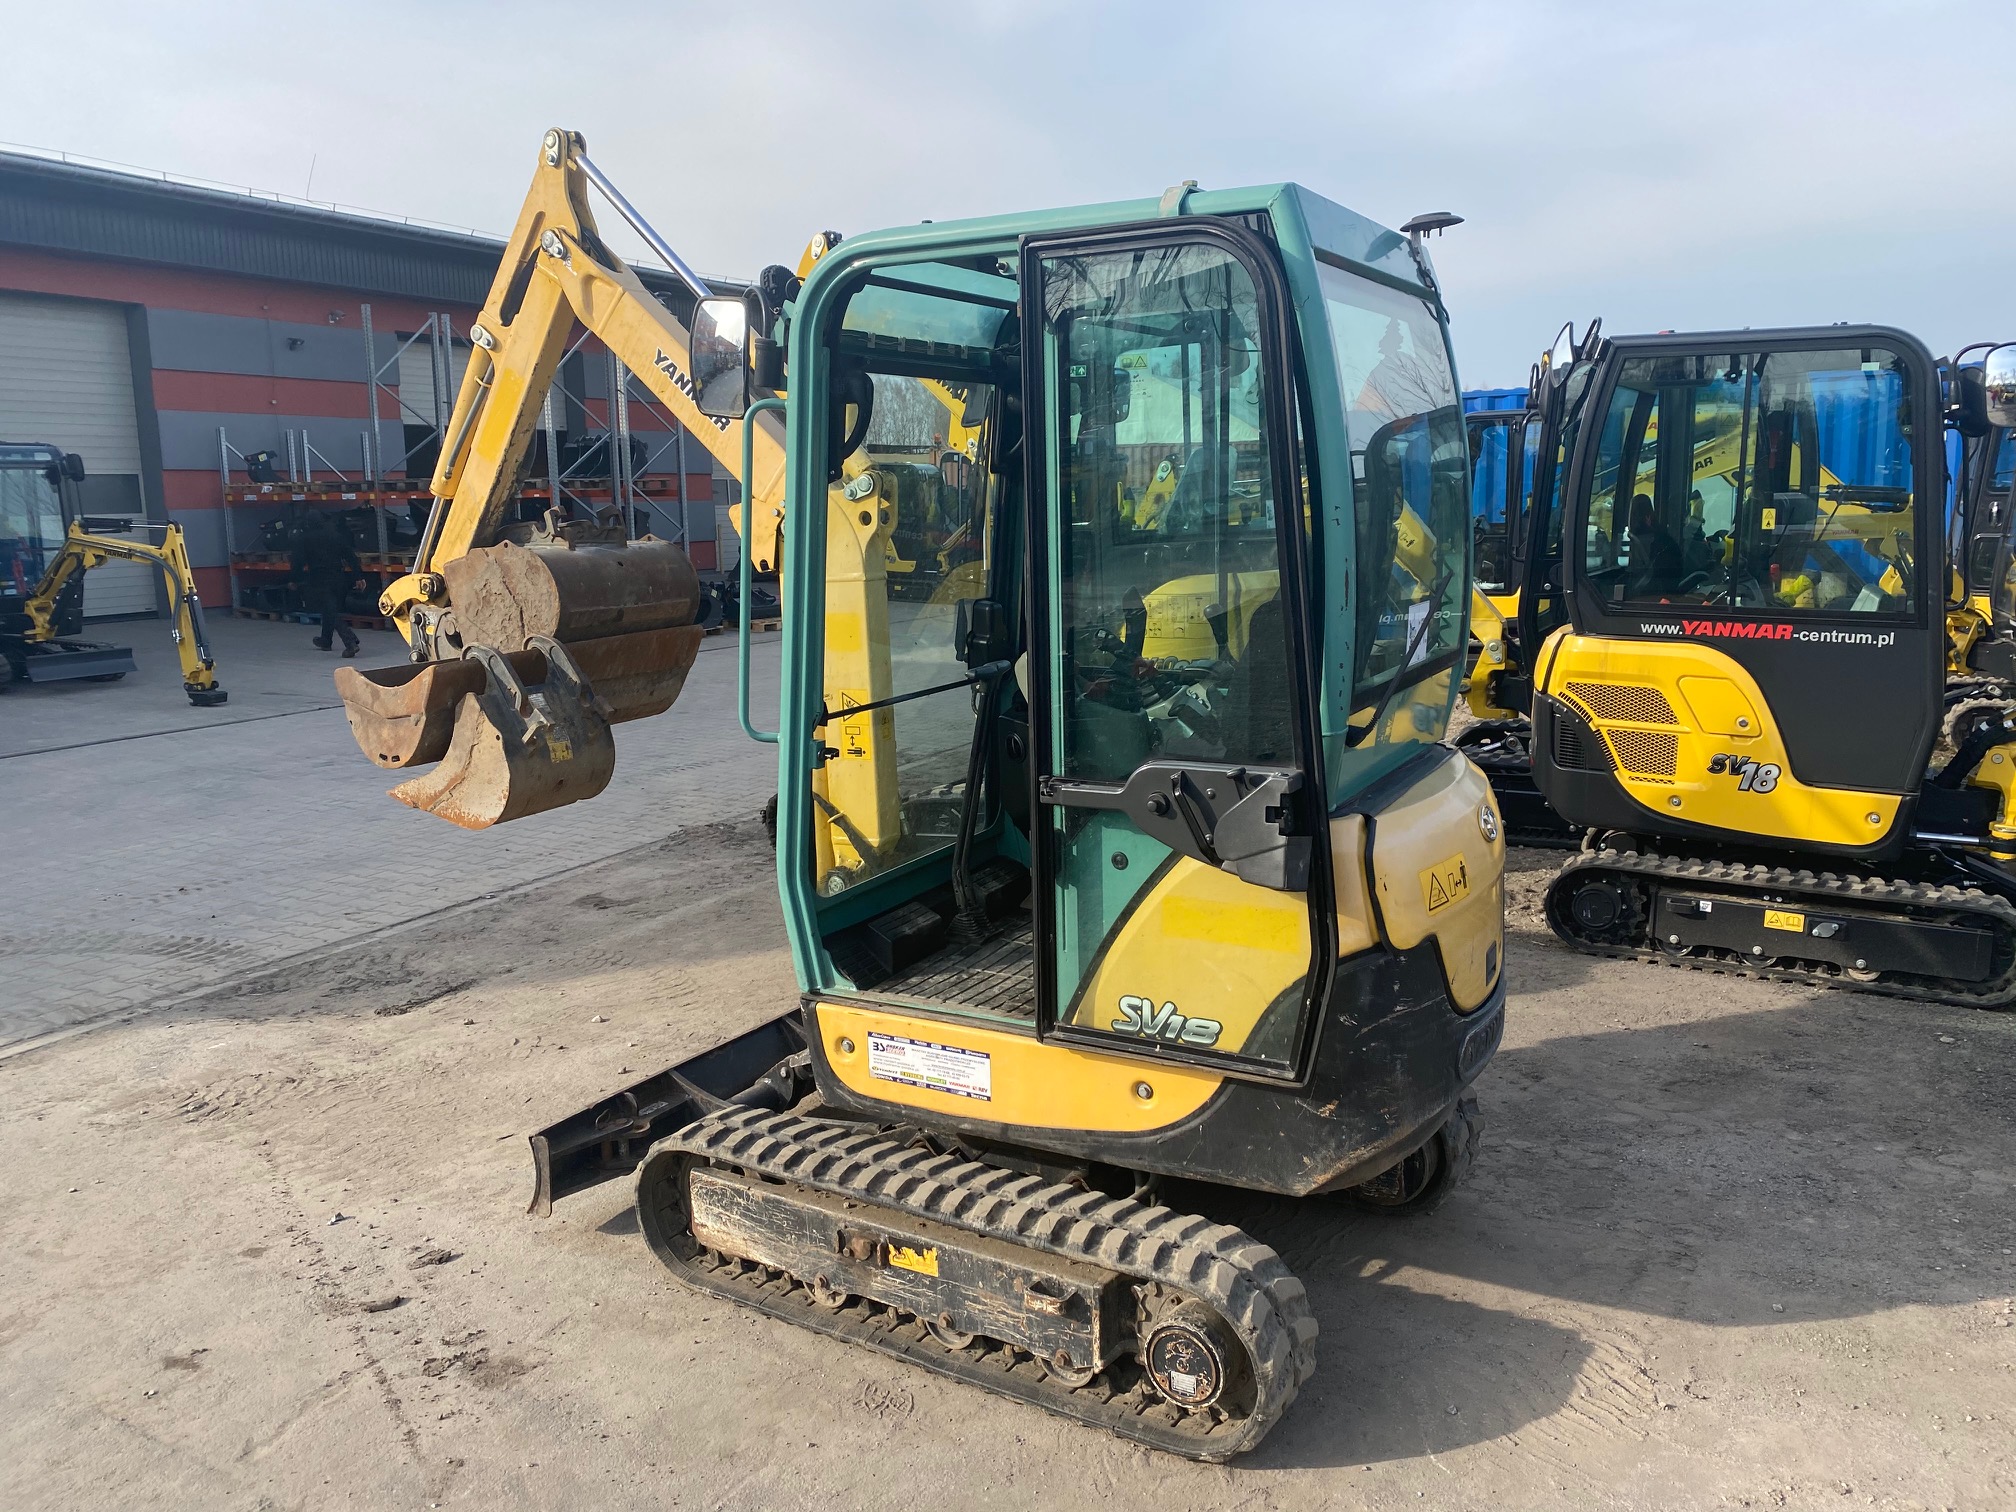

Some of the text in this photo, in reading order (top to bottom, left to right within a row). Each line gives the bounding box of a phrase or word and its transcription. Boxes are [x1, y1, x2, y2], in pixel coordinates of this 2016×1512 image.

[1641, 620, 1895, 648] www.YANMAR-centrum.pl
[1707, 753, 1782, 794] SV18
[1111, 995, 1223, 1046] SV18
